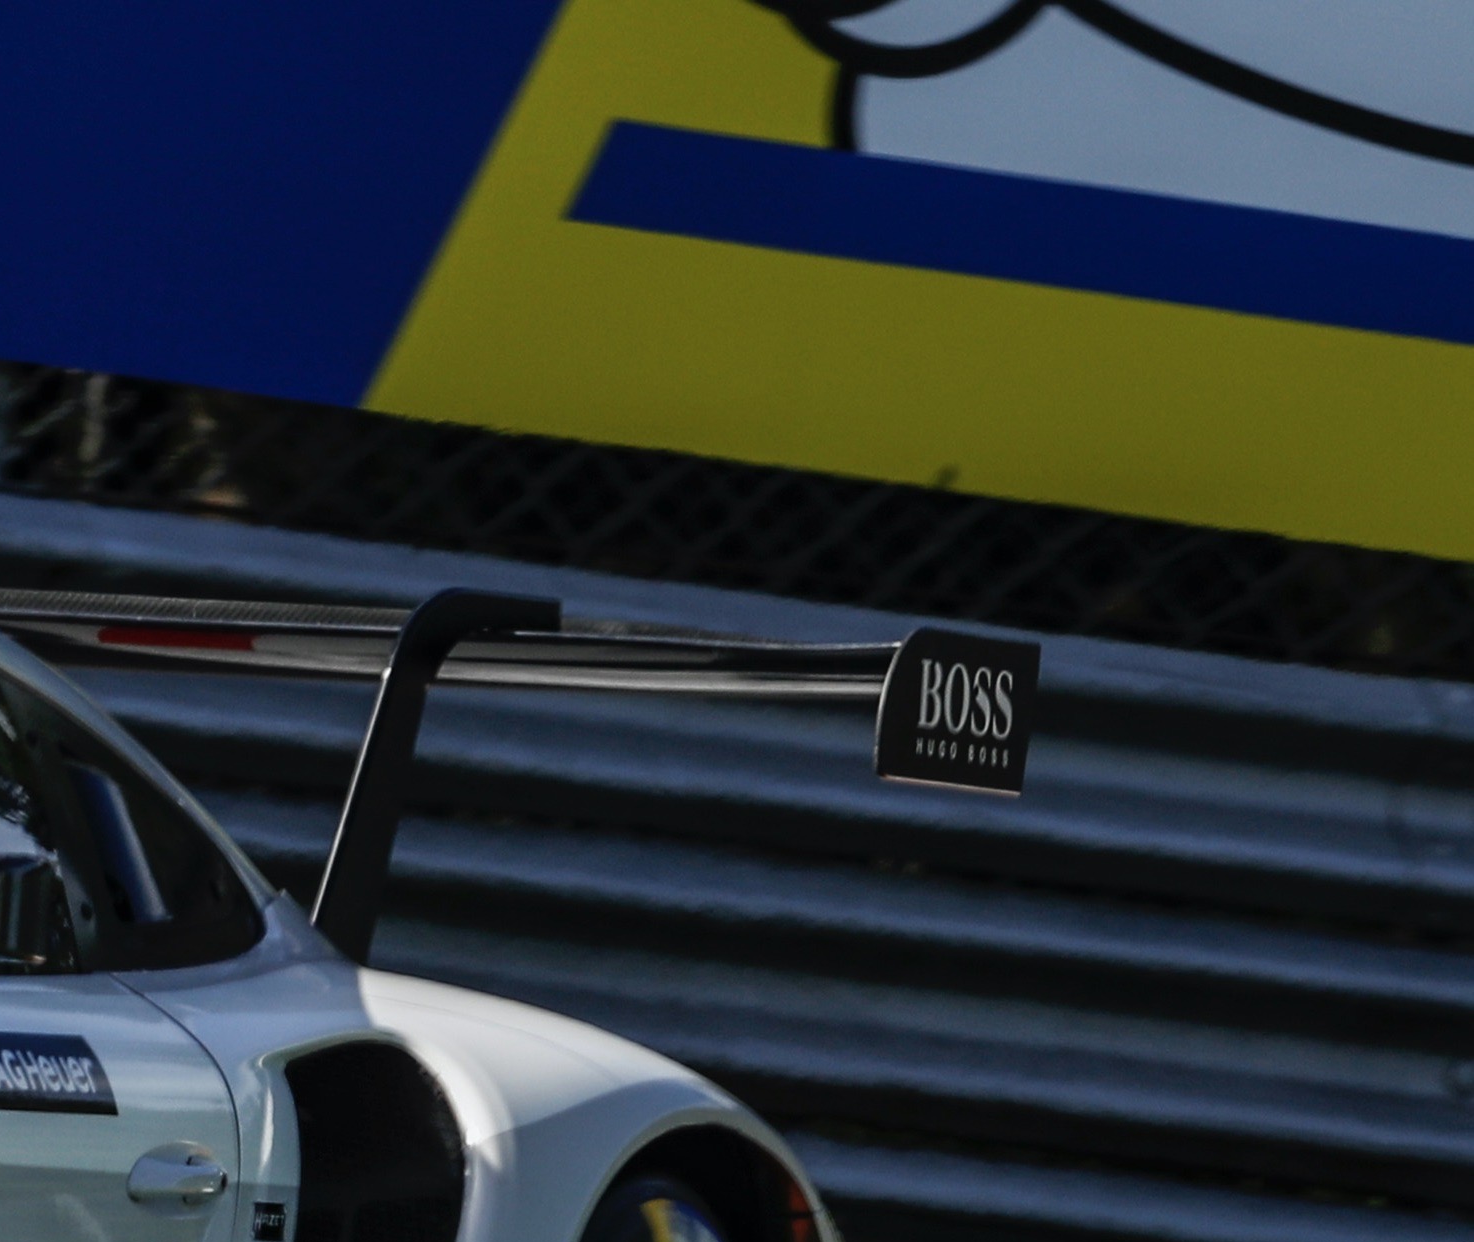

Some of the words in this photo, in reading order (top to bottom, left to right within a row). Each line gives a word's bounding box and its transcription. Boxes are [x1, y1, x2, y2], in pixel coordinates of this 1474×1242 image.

[917, 658, 1014, 740] BOSS
[915, 737, 958, 760] HUGO
[967, 743, 1010, 768] BOSS
